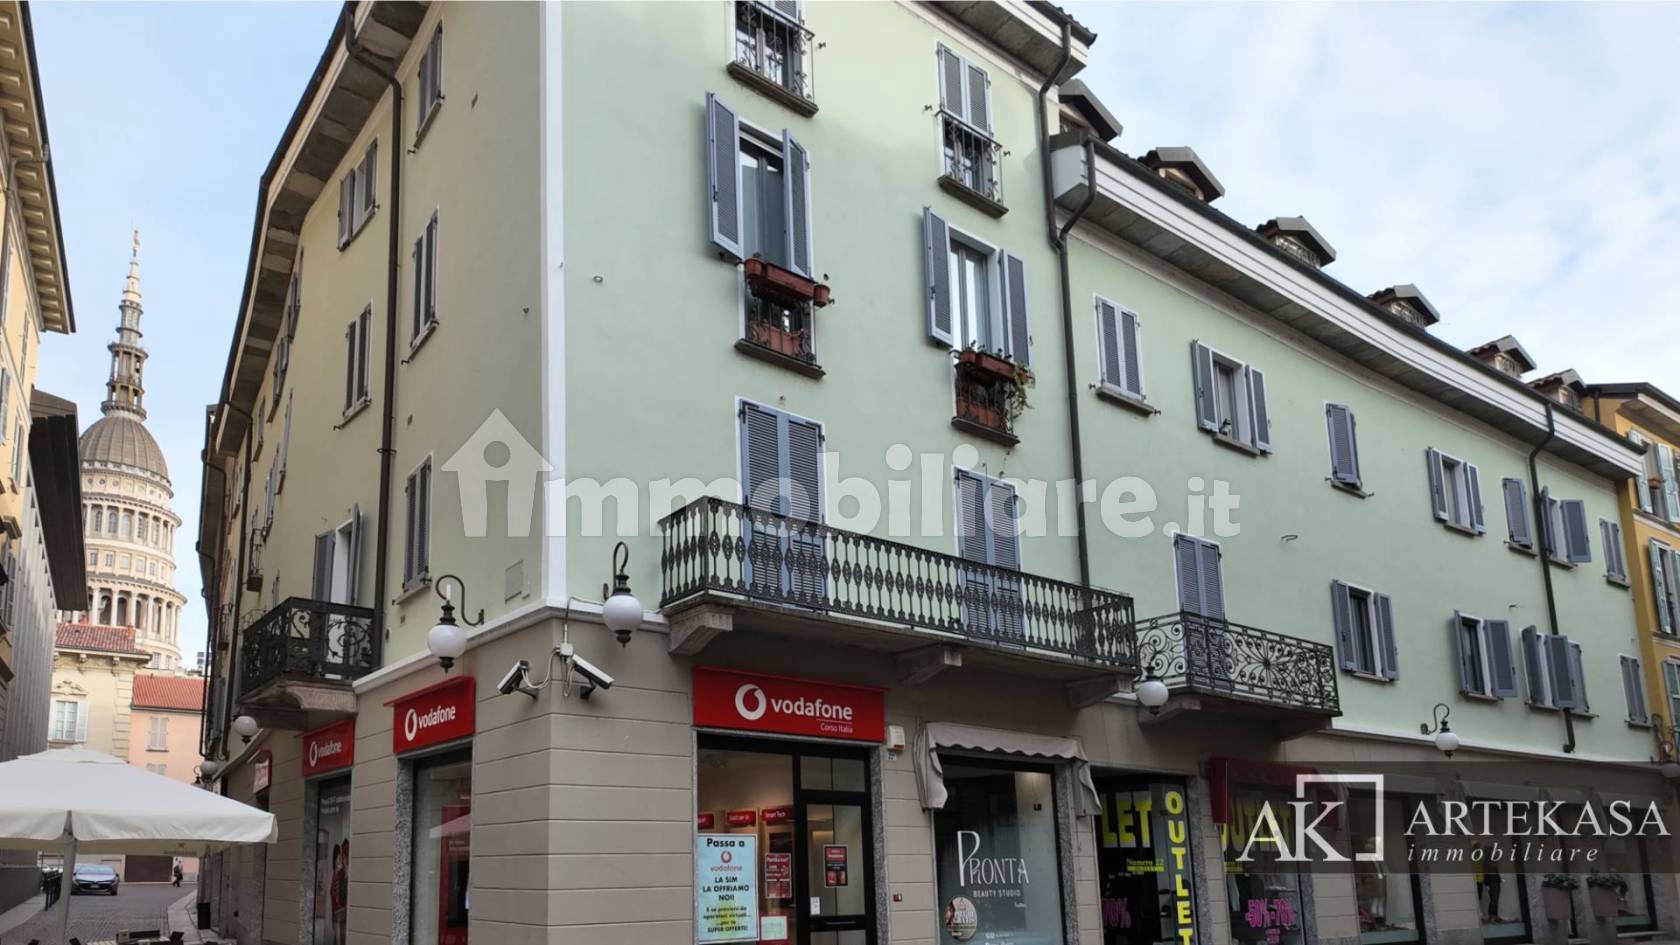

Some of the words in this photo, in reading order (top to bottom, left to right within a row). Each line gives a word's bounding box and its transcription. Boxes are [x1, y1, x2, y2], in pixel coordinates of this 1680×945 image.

[418, 705, 456, 729] vodafone
[769, 697, 853, 720] vodafone
[820, 722, 837, 732] Corso
[838, 724, 854, 733] Italia
[317, 741, 343, 758] vodafone
[706, 838, 735, 848] Passa
[739, 840, 745, 848] a
[957, 830, 1030, 888] PRONTA
[1165, 790, 1193, 945] OUTLET
[713, 884, 750, 892] OFFRIAMO
[973, 889, 997, 898] BEAUTY
[999, 888, 1021, 897] STUDIO
